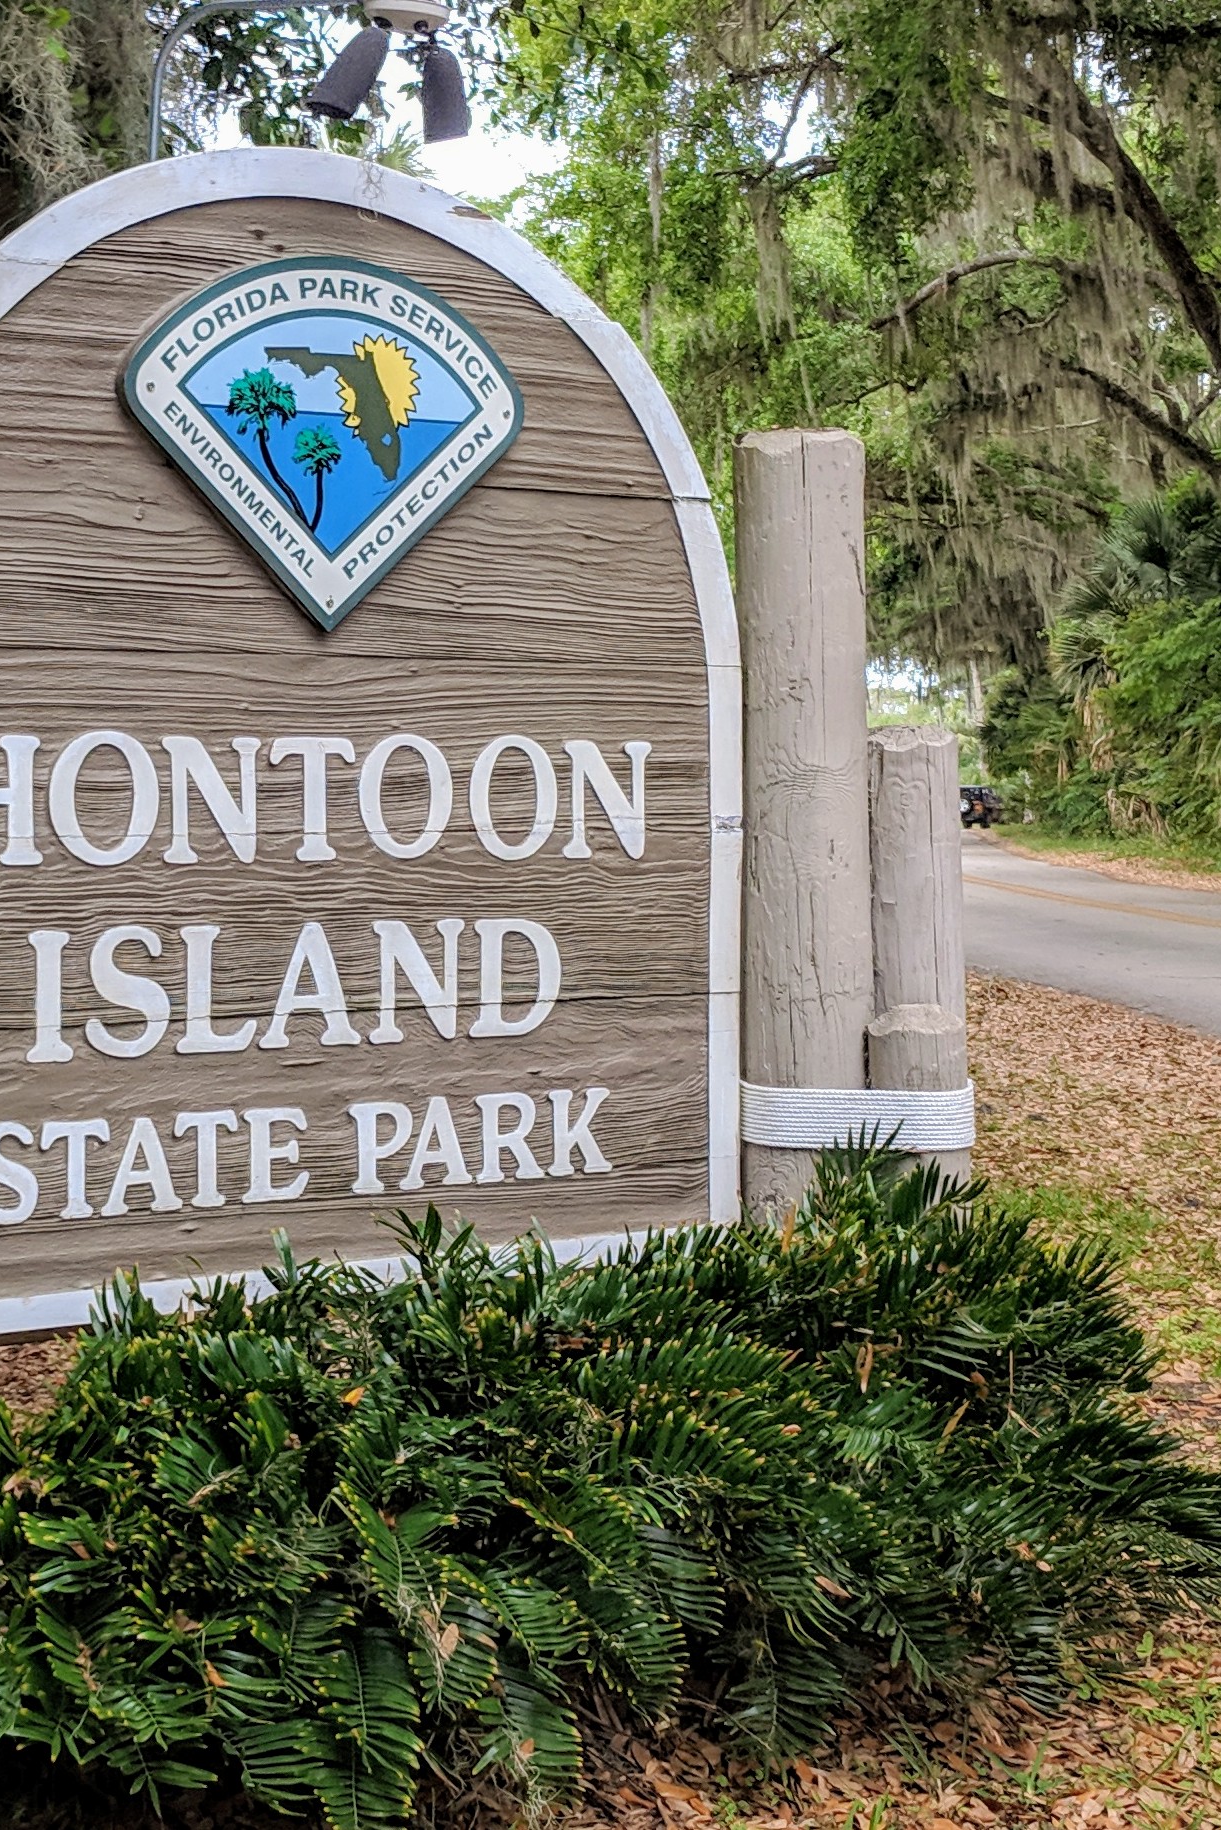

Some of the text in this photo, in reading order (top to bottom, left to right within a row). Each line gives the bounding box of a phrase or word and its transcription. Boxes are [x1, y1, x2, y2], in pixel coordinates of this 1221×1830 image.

[160, 277, 499, 400] FLORIDA PARK SERVICE
[162, 400, 314, 579] ENVIRONMENTAL
[342, 423, 492, 580] PROTECTION
[25, 918, 563, 1064] ISLAND
[347, 1087, 613, 1195] PARK
